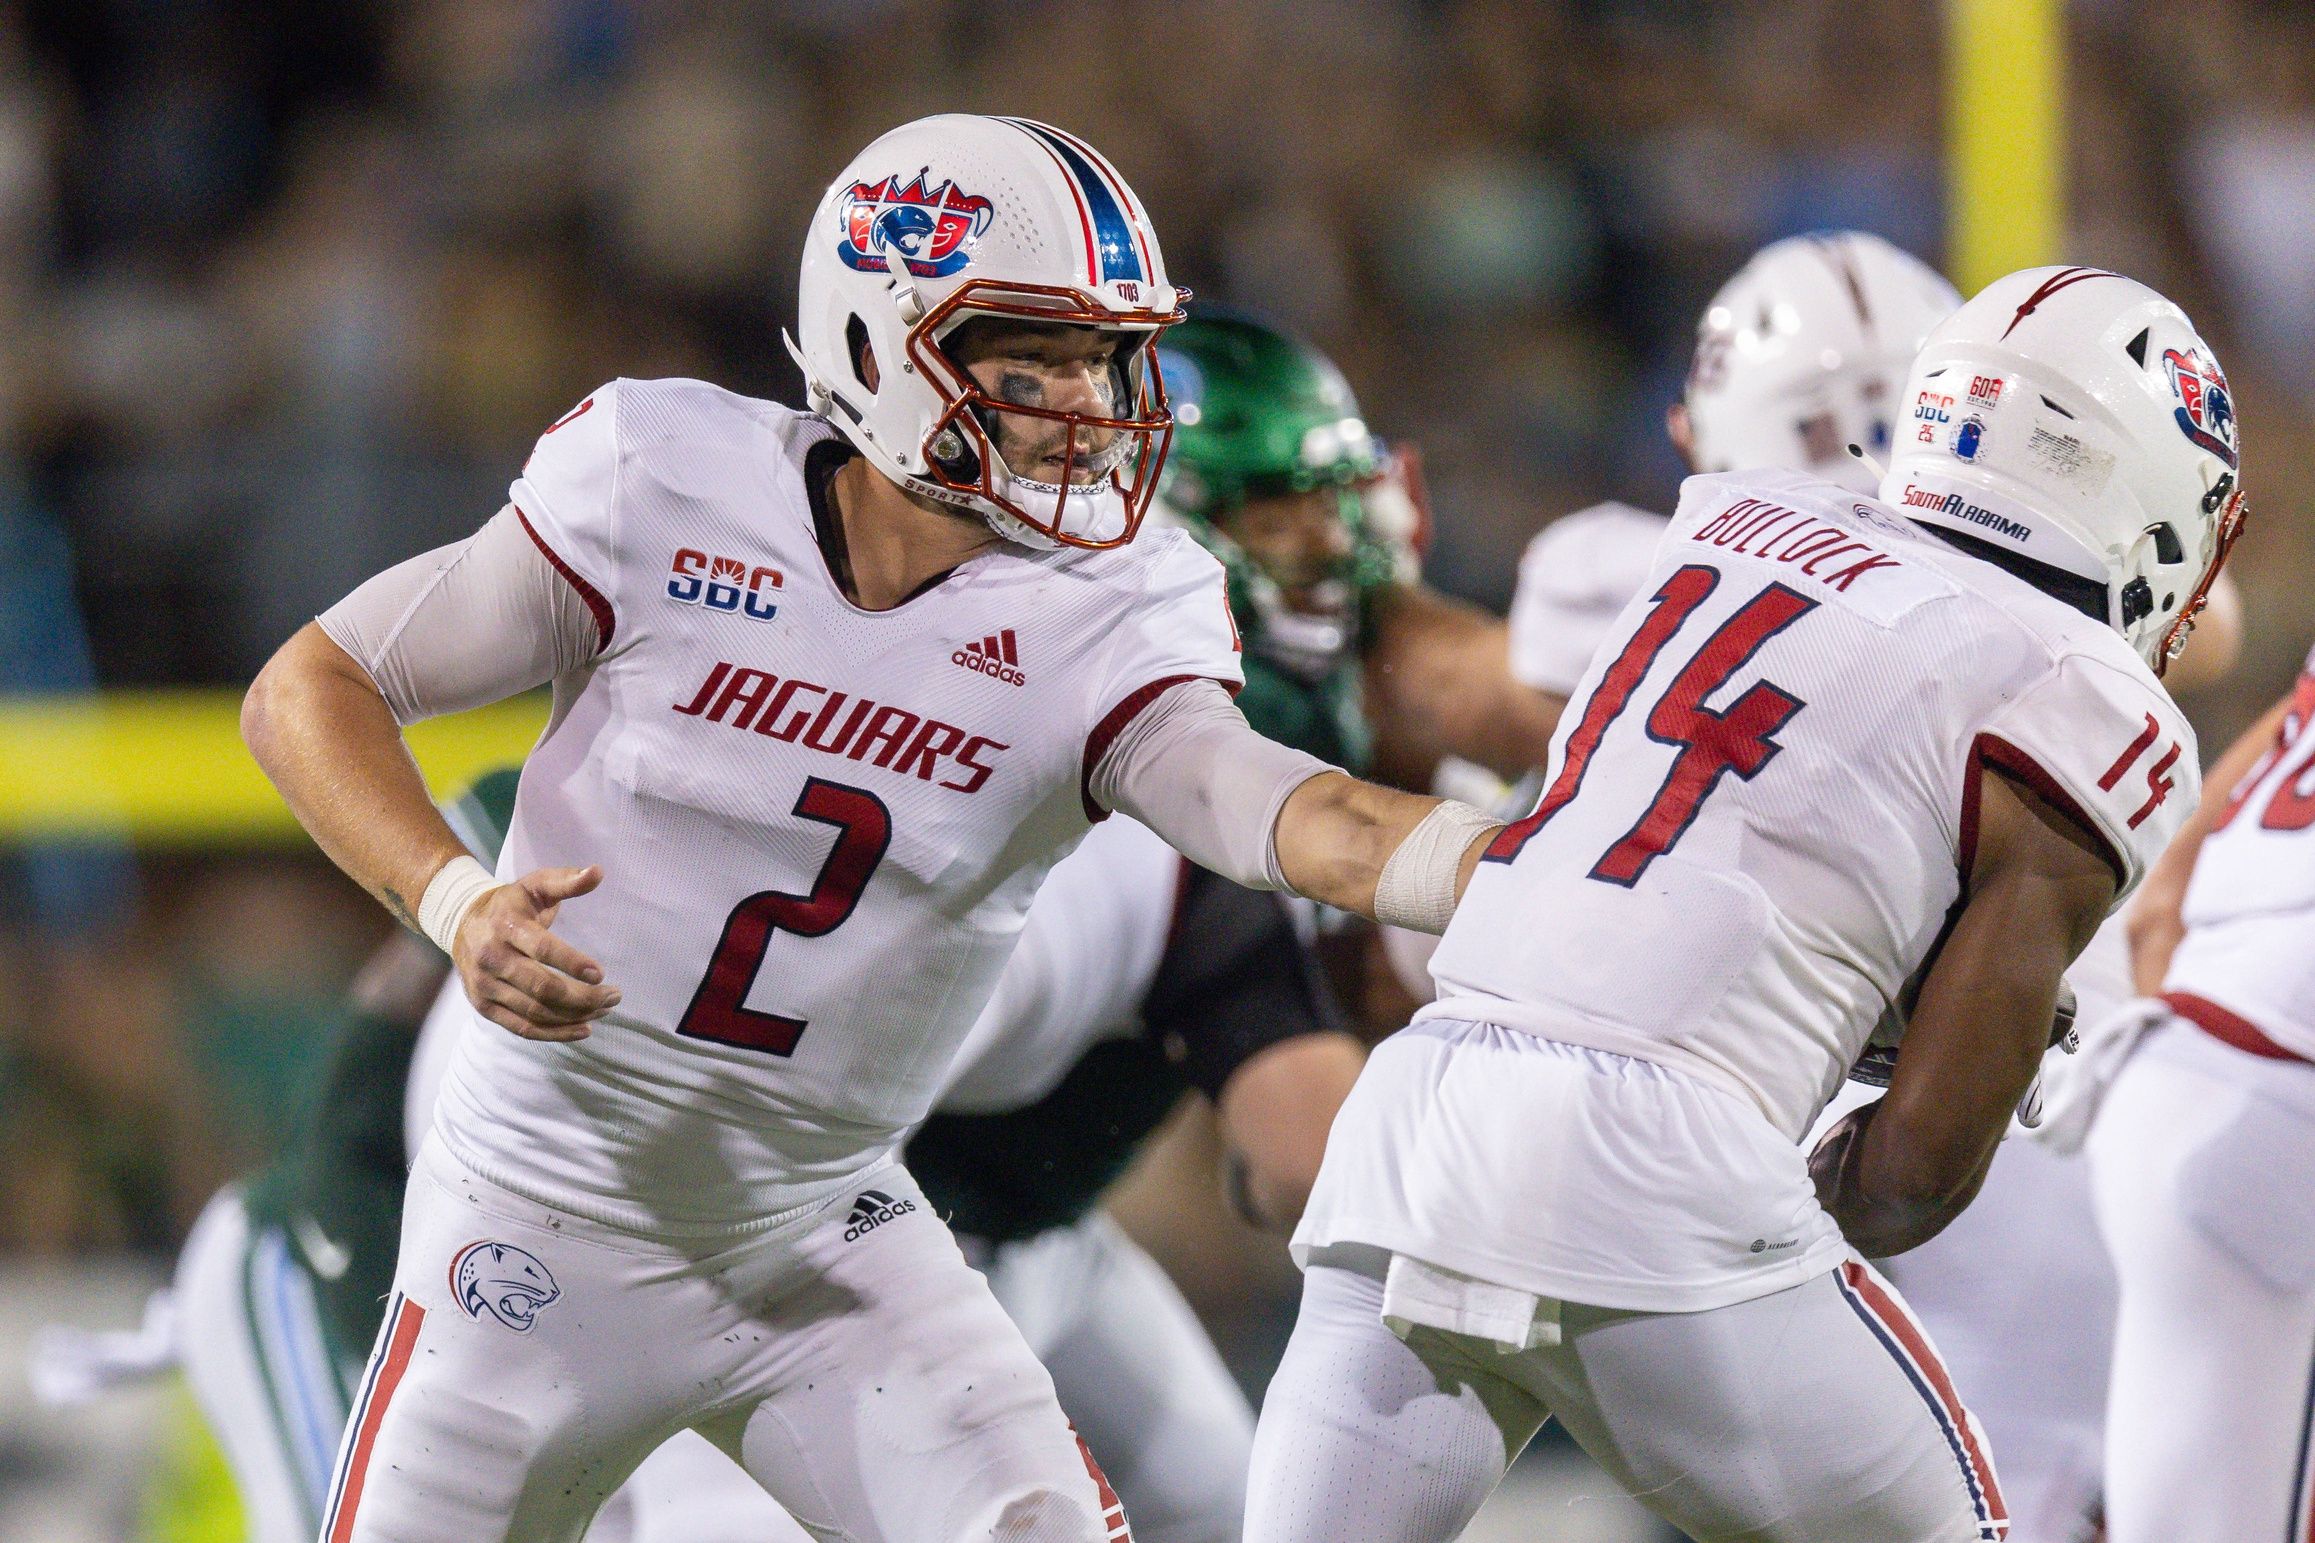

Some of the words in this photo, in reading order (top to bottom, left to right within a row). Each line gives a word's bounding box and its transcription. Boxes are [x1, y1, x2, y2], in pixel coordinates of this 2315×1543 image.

[1116, 282, 1140, 302] 1703
[904, 478, 961, 504] SPORT
[667, 546, 785, 623] SBC
[1692, 498, 1903, 593] BULLOCK
[951, 647, 1027, 689] adidas
[671, 661, 1012, 794] JAGUARS
[1480, 563, 1822, 890] 14
[2097, 711, 2182, 832] 14
[675, 775, 893, 1059] 2
[843, 1199, 917, 1243] adidas
